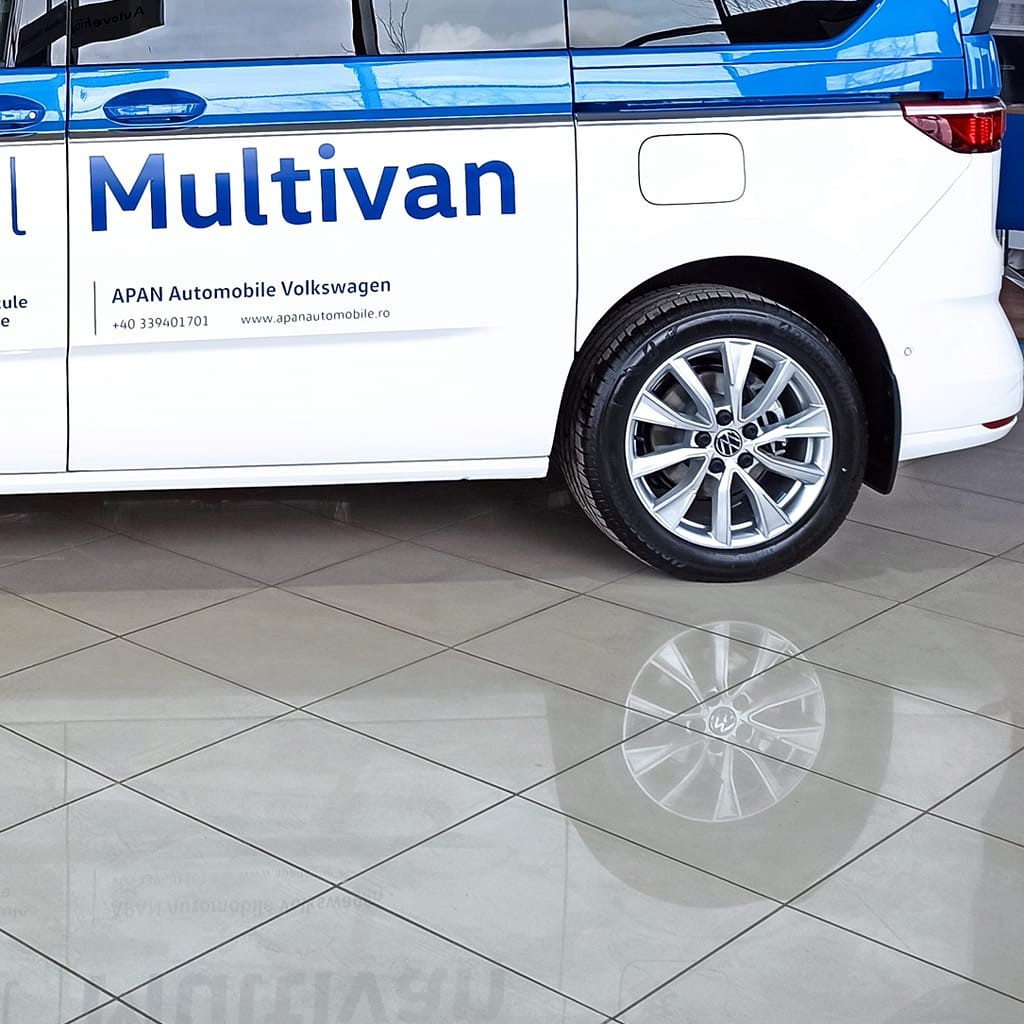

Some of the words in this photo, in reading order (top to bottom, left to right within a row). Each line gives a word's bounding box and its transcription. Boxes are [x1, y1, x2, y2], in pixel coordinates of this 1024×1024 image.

[89, 143, 517, 232] Multivan
[111, 286, 163, 304] APAN
[168, 281, 277, 302] Automobile
[280, 276, 391, 298] Volkswagen
[112, 319, 136, 330] +40
[139, 315, 210, 329] 339401701
[240, 308, 391, 326] www.apanautomobile.ro
